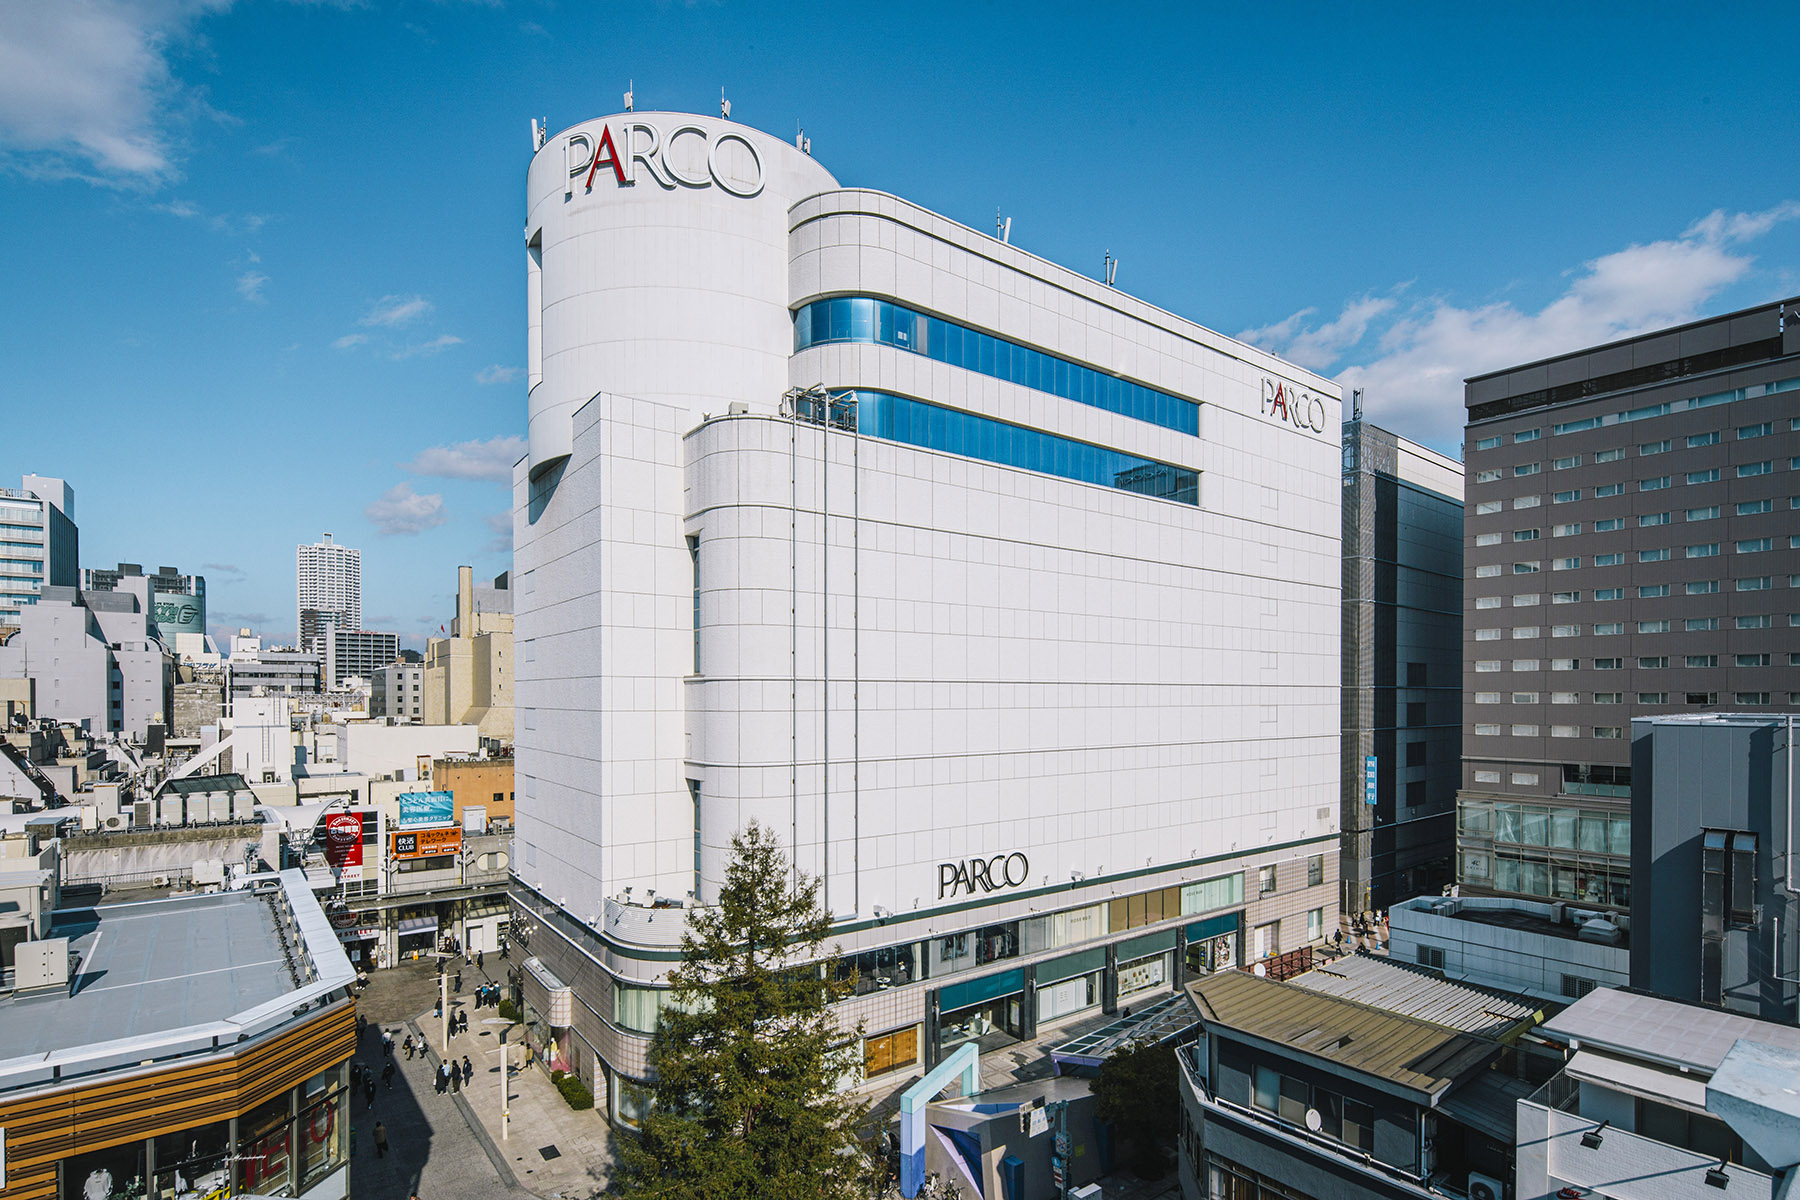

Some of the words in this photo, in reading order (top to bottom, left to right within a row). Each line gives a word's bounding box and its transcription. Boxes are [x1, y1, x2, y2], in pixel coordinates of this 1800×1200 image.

[563, 122, 766, 200] PARCO
[1261, 376, 1326, 433] PARCO
[1367, 760, 1375, 800] 四国銀行
[398, 836, 414, 845] 快活
[938, 852, 1029, 900] PARCO
[344, 928, 373, 936] STREET
[1562, 1186, 1581, 1197] NIKE
